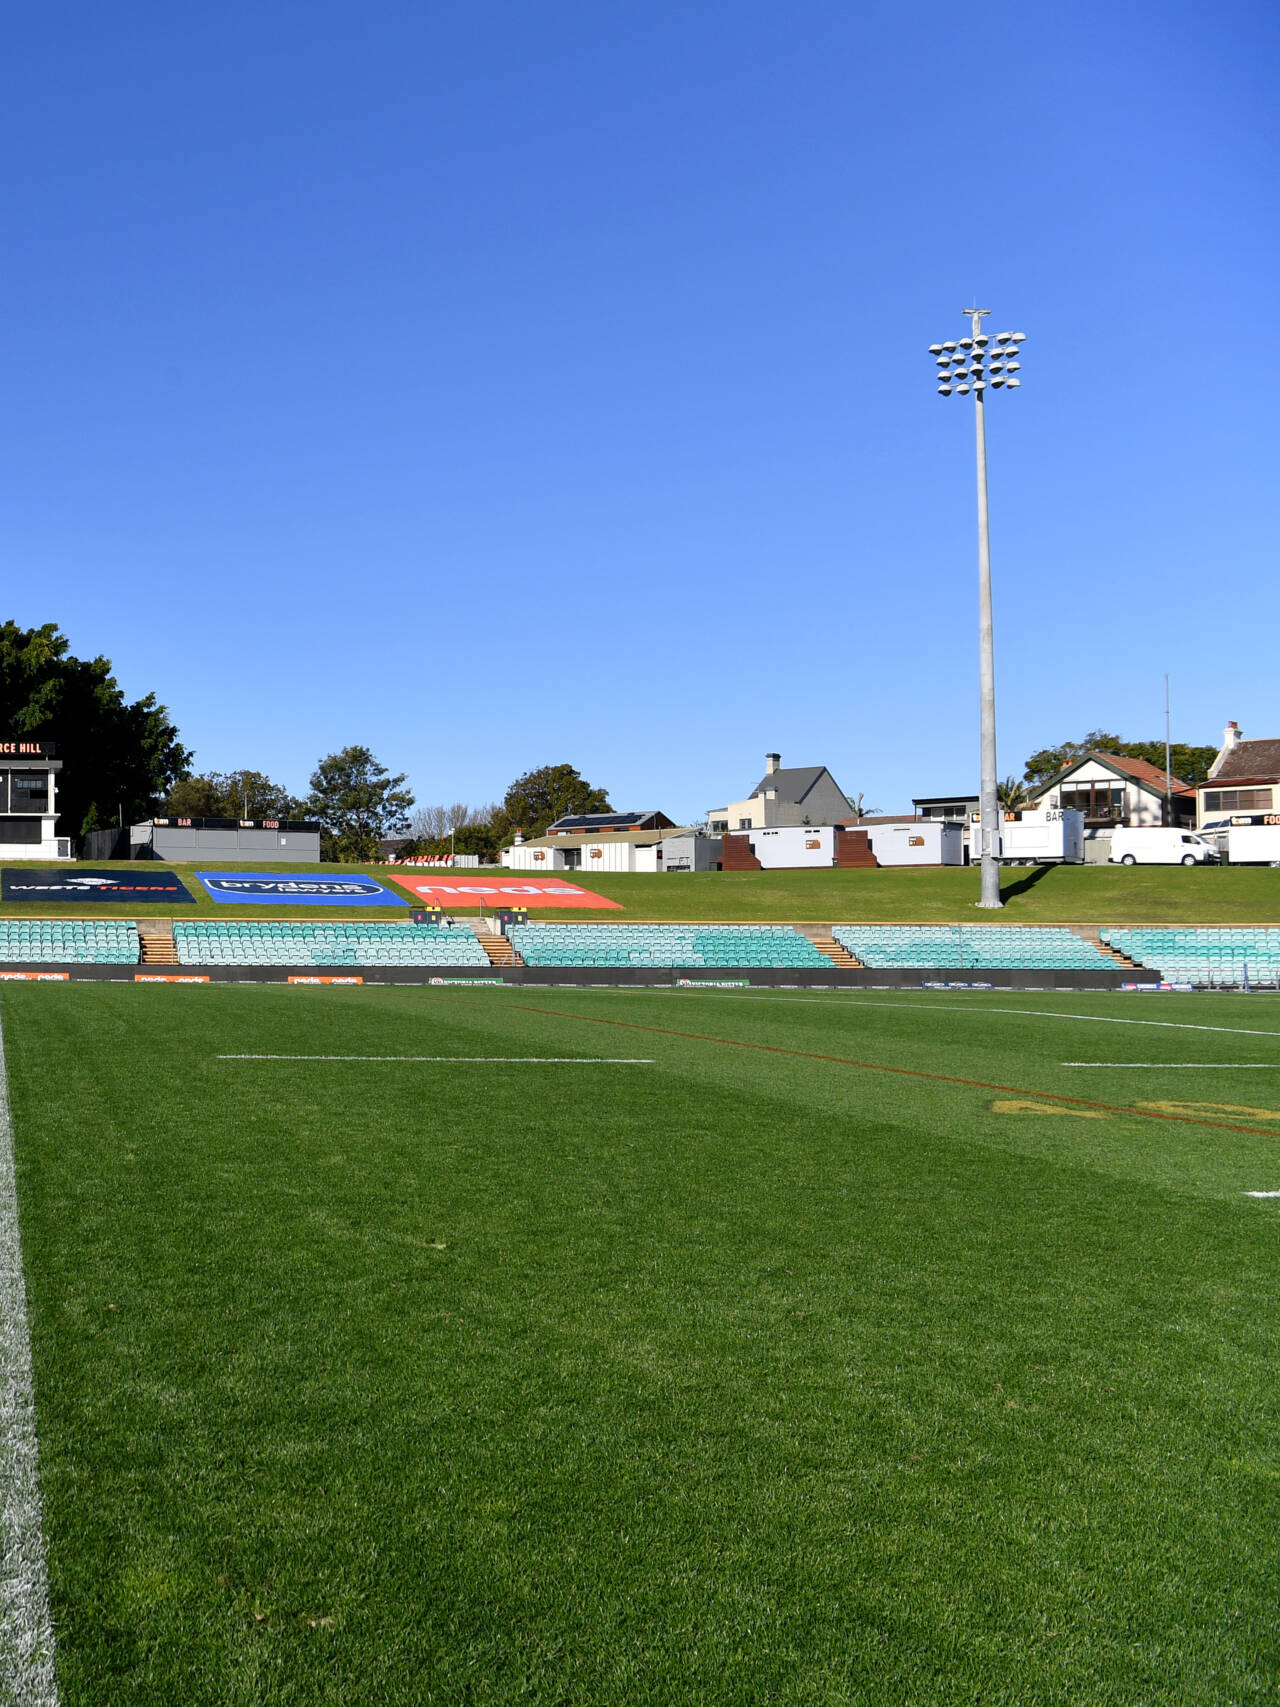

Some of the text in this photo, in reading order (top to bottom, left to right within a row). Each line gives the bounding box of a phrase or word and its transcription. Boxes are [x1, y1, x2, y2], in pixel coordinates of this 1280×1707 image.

[19, 743, 42, 753] HILL
[1045, 811, 1064, 822] BAR
[177, 818, 192, 826] BAR
[262, 820, 280, 828] FOOD
[221, 881, 362, 890] brydens
[415, 885, 586, 895] neds
